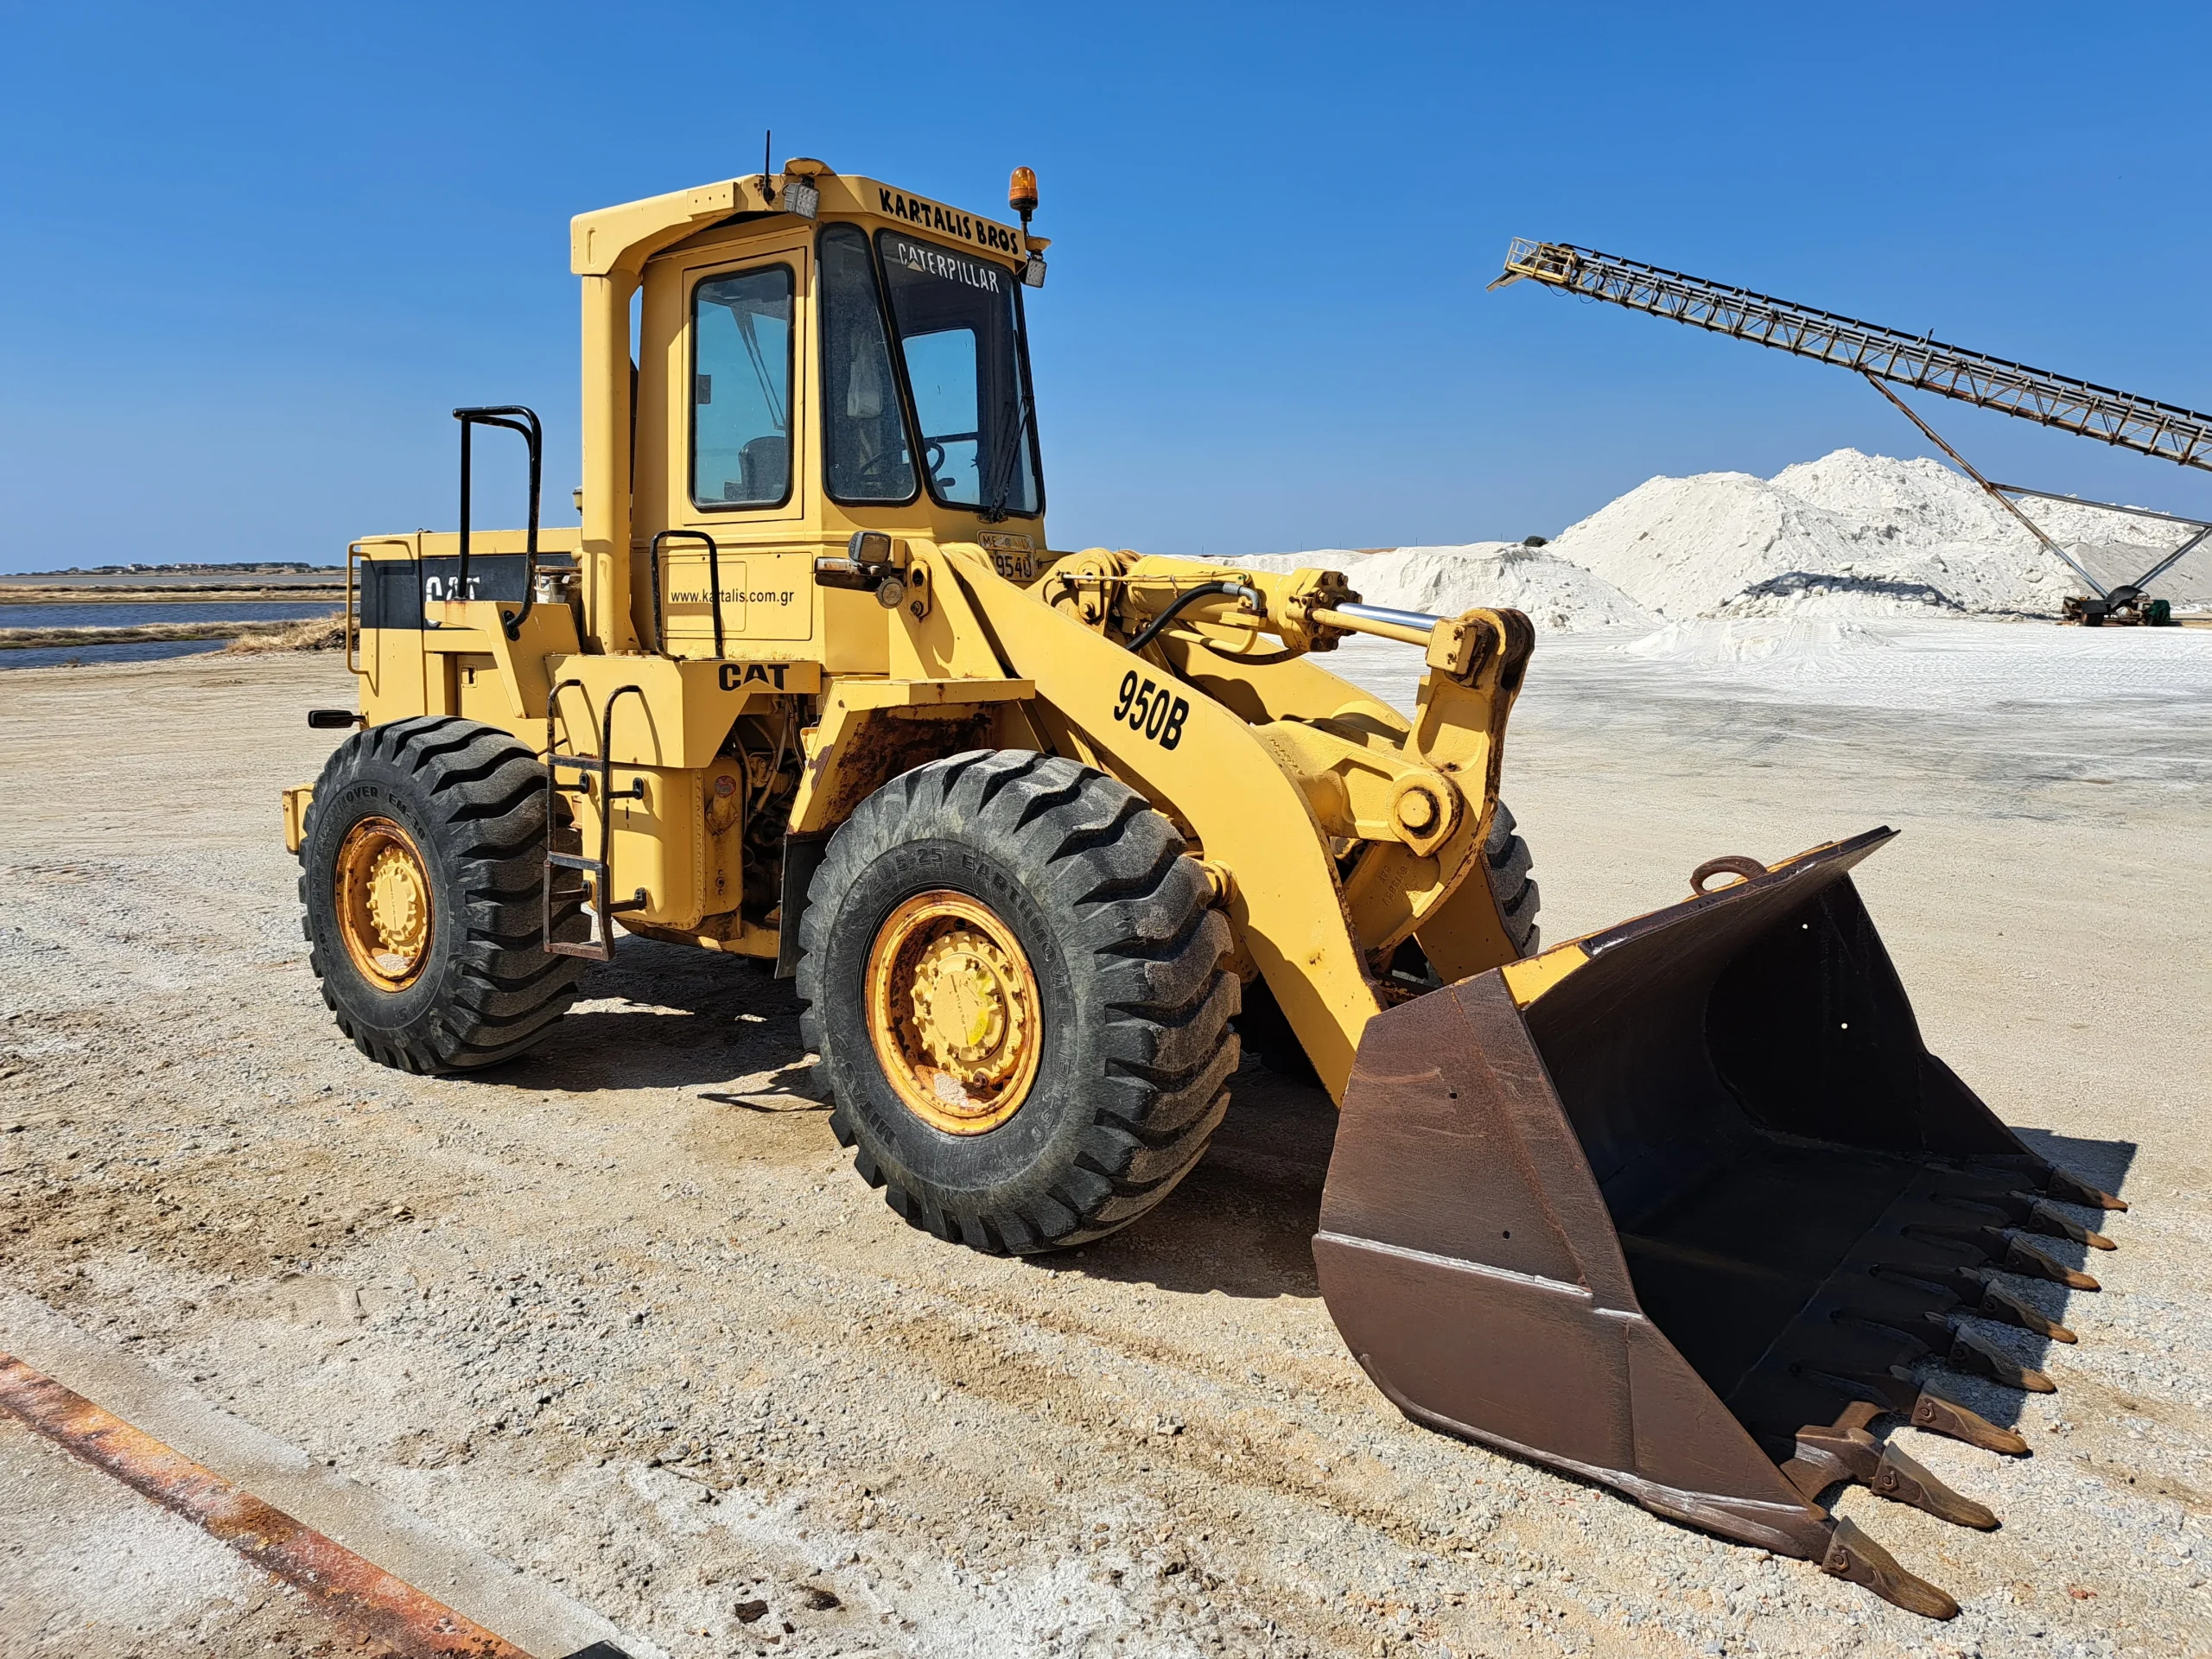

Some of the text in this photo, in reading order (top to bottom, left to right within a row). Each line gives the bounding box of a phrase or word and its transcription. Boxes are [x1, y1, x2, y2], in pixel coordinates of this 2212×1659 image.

[878, 188, 1019, 255] KARTALIS BROS
[898, 243, 1000, 294] CATERPILLAR
[671, 588, 795, 606] www.katalis.com.gr
[718, 664, 790, 691] CAT
[1113, 670, 1190, 751] 950B
[961, 853, 1073, 1029] EARTHMOVER
[840, 1061, 897, 1147] MITAS
